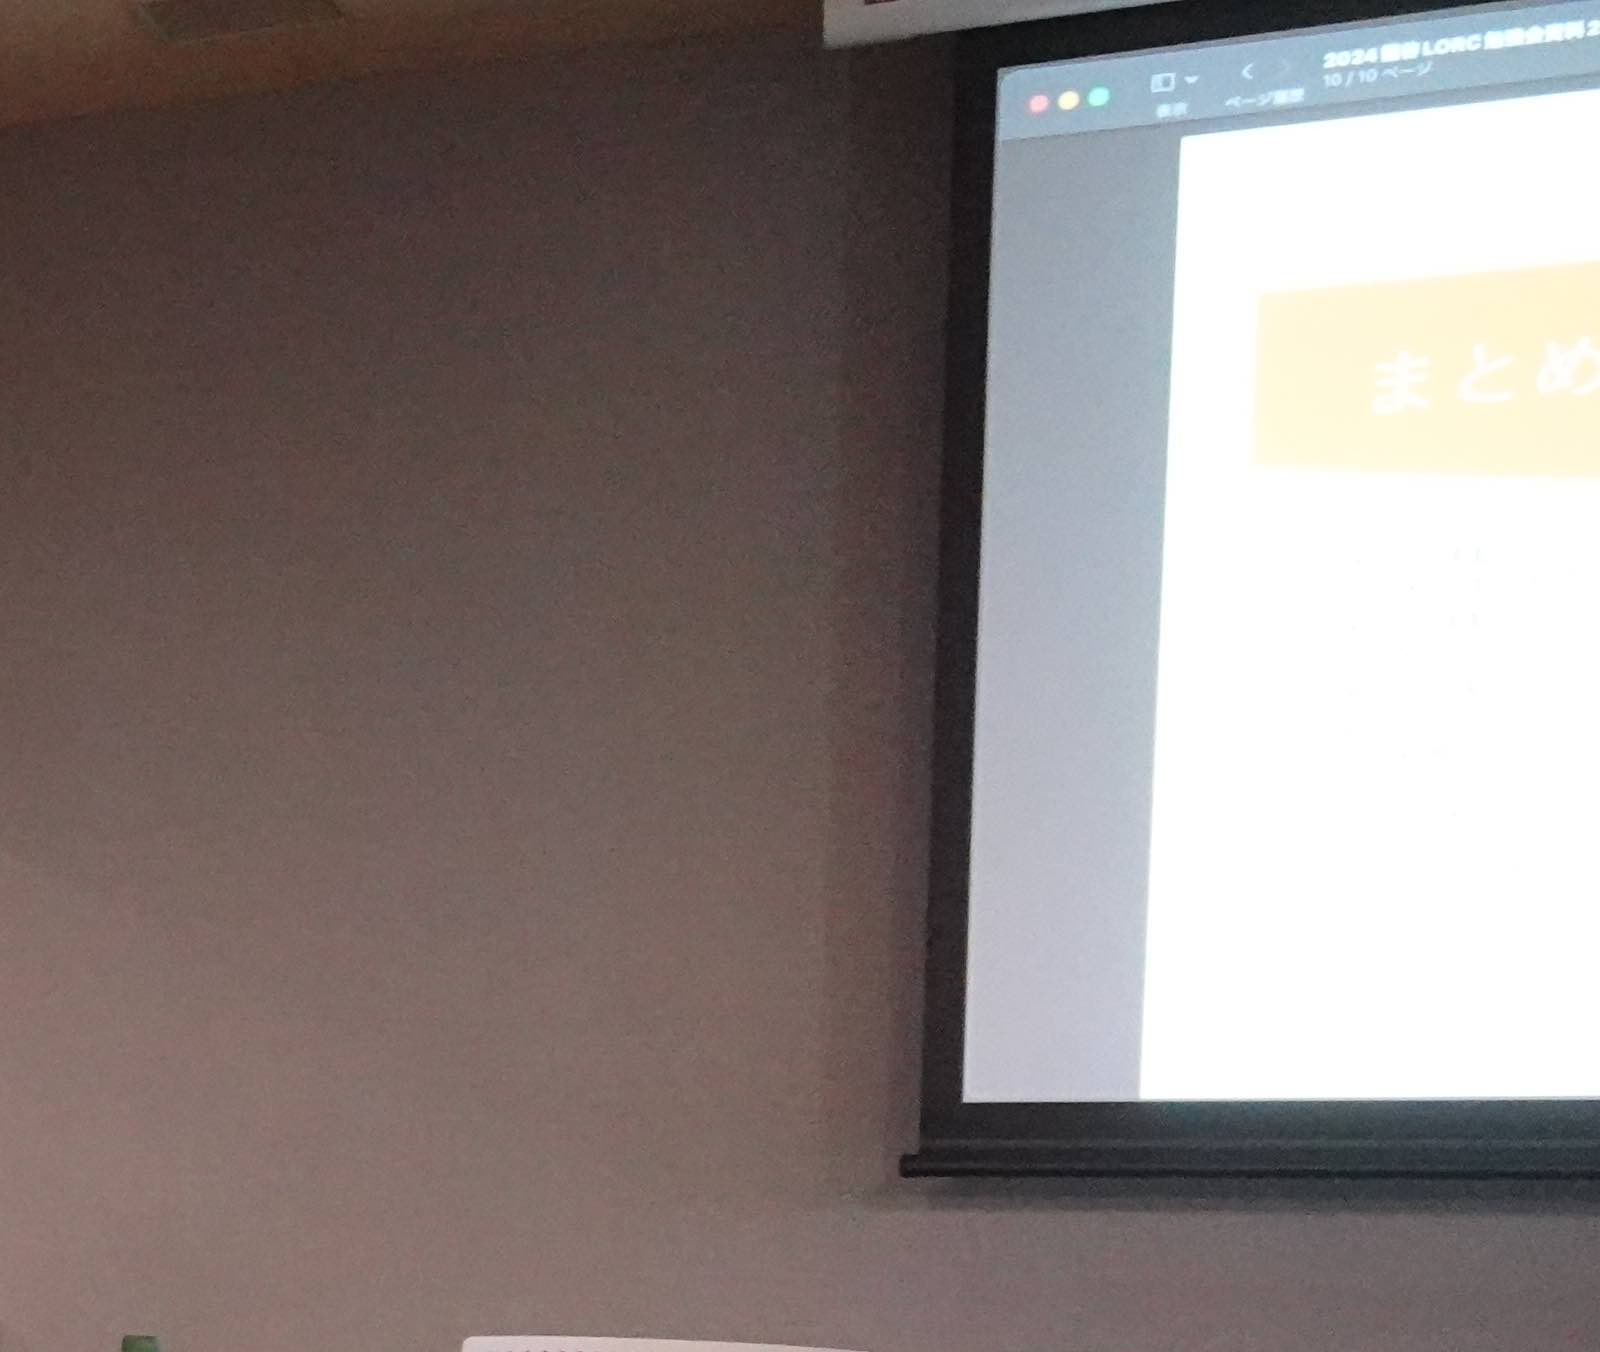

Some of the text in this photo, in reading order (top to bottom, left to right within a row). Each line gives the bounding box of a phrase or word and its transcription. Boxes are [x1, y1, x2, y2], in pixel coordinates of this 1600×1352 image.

[1323, 48, 1378, 69] 2024
[1372, 335, 1600, 416] まとめ
